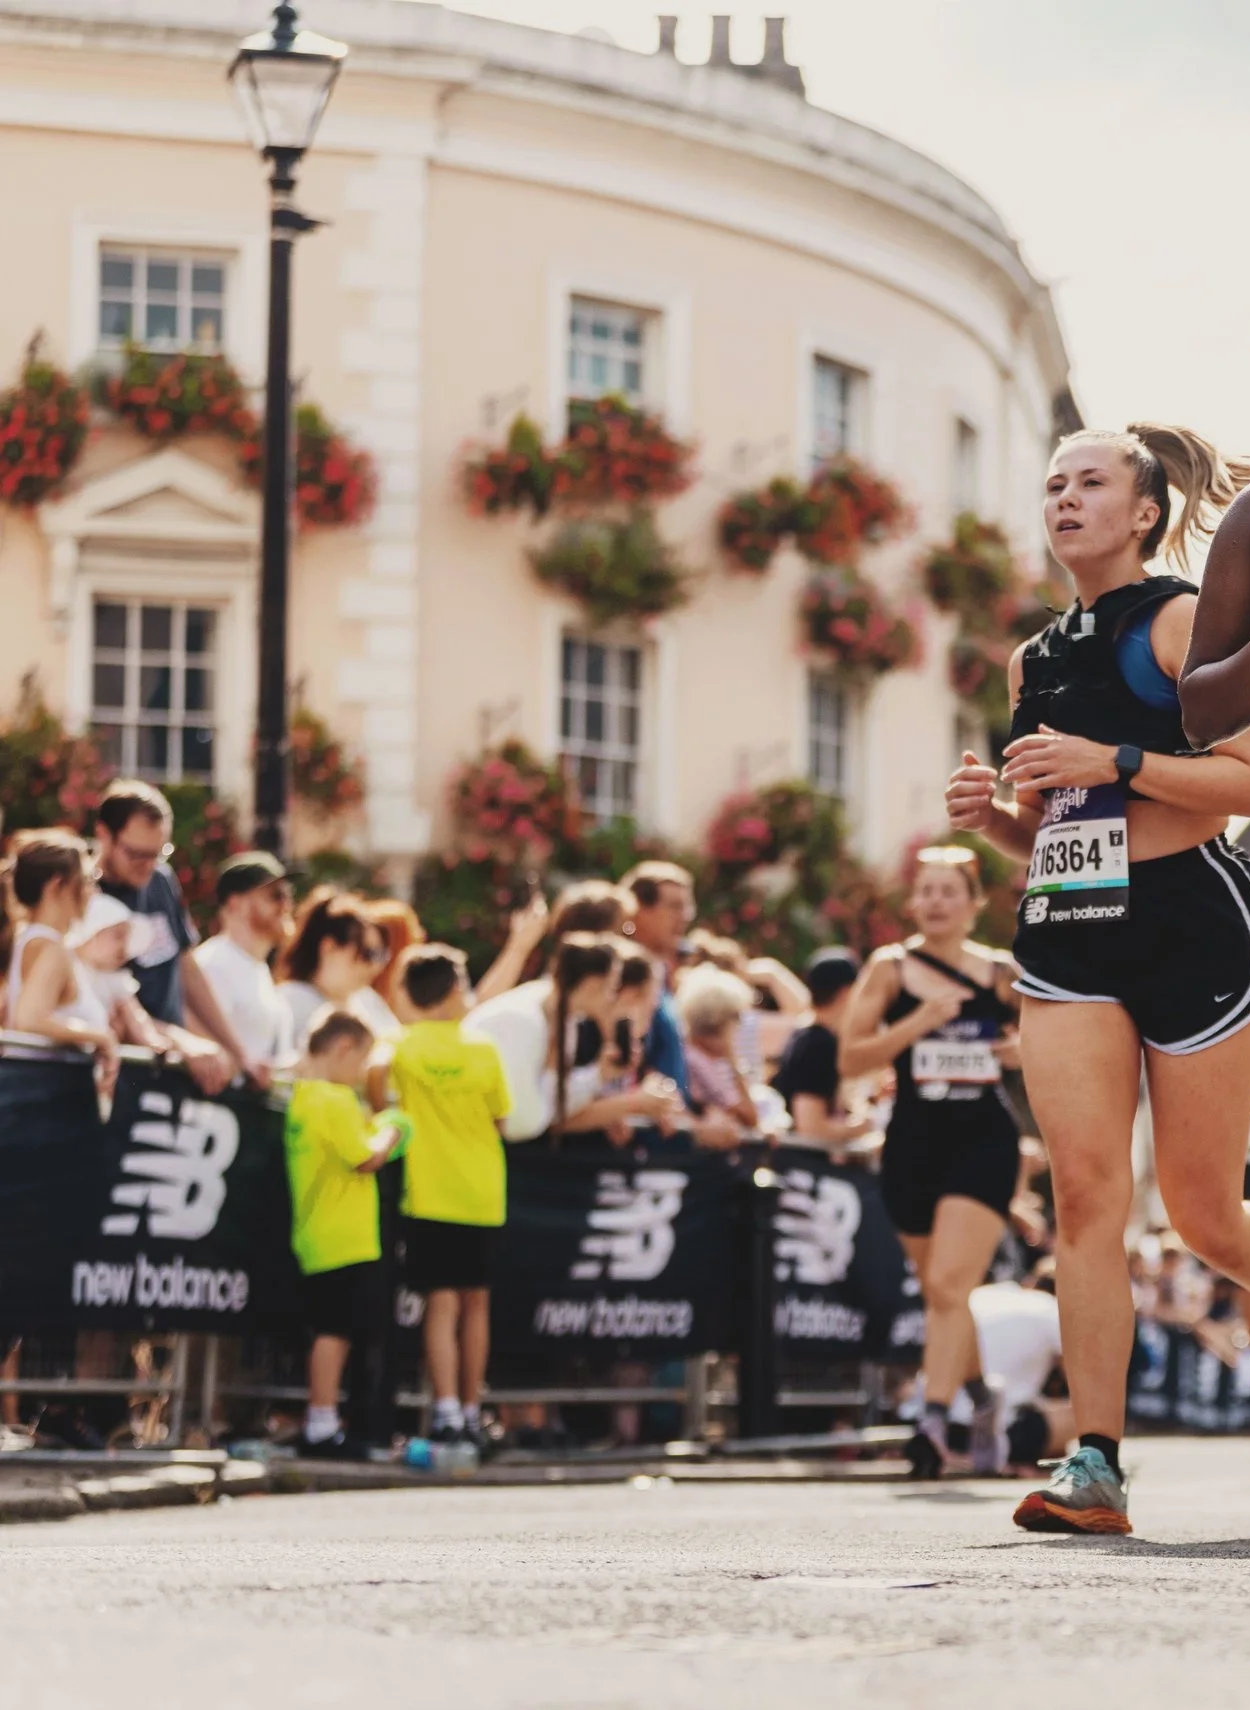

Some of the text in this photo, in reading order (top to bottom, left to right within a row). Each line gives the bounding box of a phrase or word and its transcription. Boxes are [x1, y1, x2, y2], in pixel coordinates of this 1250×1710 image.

[1050, 910, 1071, 922] new
[1072, 904, 1125, 920] balance
[72, 1254, 250, 1312] new balance
[535, 1294, 694, 1339] new balance
